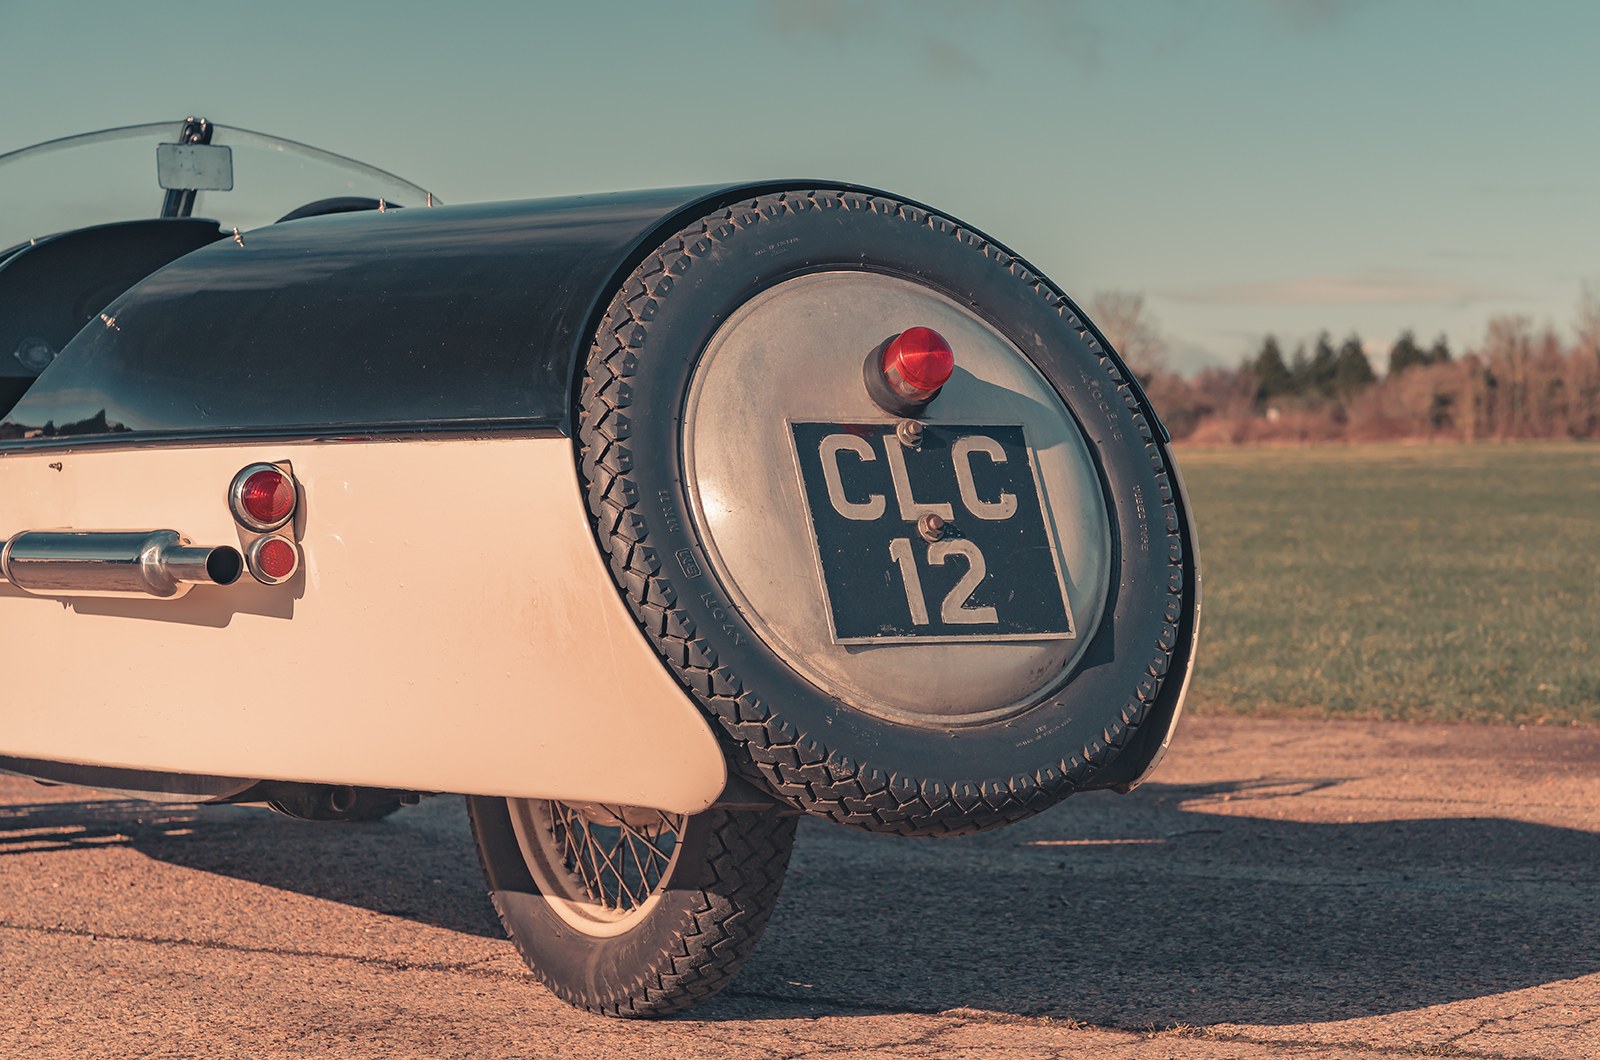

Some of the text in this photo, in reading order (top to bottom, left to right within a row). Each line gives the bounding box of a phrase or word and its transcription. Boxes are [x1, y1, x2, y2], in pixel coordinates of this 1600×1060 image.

[819, 433, 1018, 521] CLC
[1139, 523, 1150, 552] TYPE
[888, 537, 999, 626] 12
[700, 591, 749, 646] AVON
